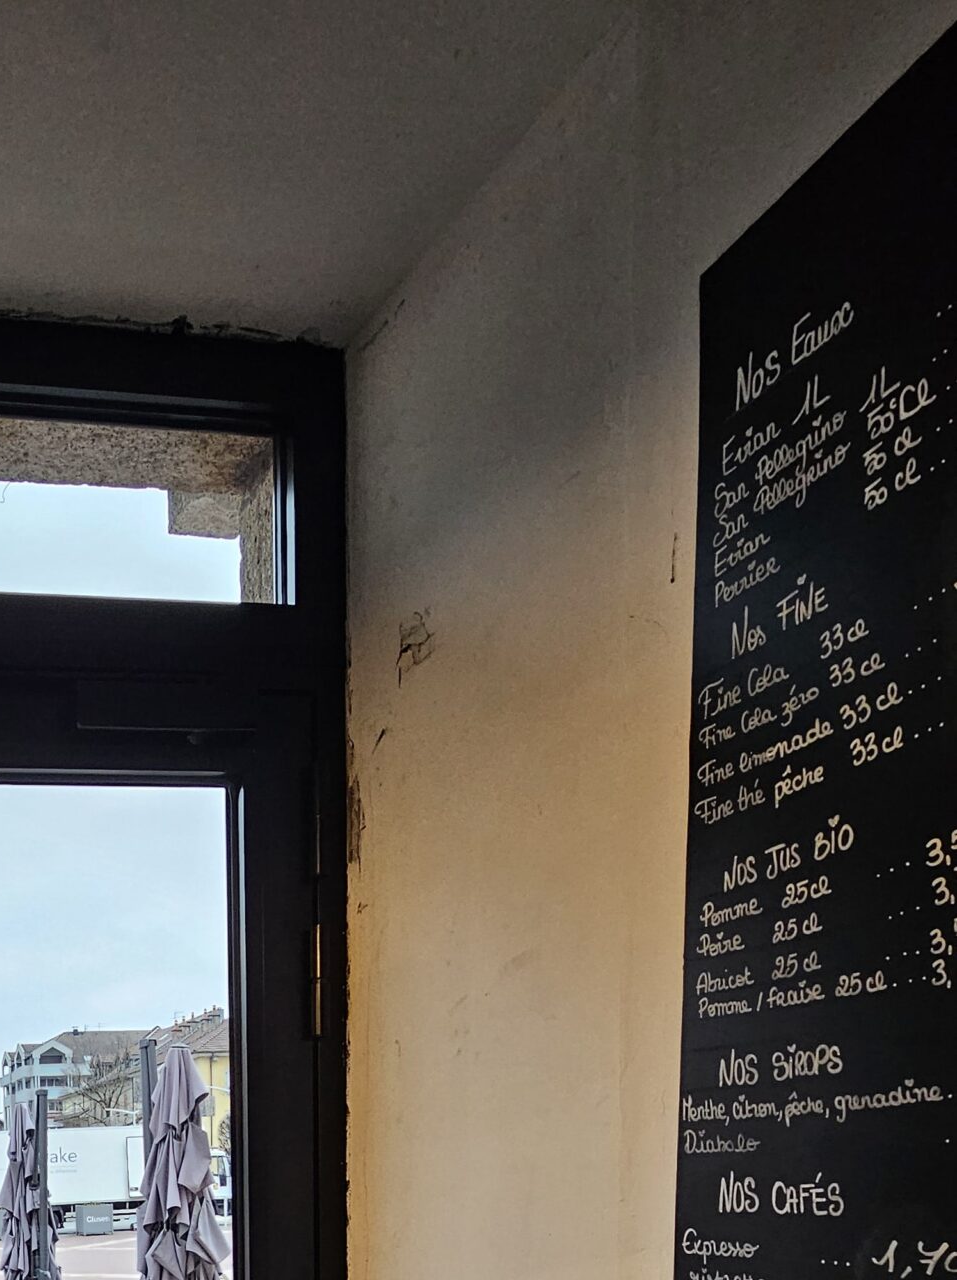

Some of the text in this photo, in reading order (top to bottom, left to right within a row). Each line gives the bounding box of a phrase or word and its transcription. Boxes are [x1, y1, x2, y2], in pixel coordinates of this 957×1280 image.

[736, 302, 854, 411] Nos Eaux
[715, 366, 901, 518] San Pellegrino 1L
[723, 375, 831, 476] Evian 1L
[713, 514, 749, 547] San
[753, 442, 851, 514] Pellegrino
[715, 533, 770, 577] Evian
[732, 606, 766, 659] Nos
[698, 678, 741, 719] Fine
[748, 664, 790, 696] Cola
[697, 759, 734, 787] Fine
[739, 717, 834, 773] limonade
[699, 723, 736, 749] Fine
[741, 708, 777, 734] Cola
[694, 796, 733, 824] Fine
[737, 778, 765, 811] thé
[774, 764, 824, 808] pêche
[723, 856, 758, 893] NOS
[764, 843, 801, 880] JUS
[700, 898, 763, 928] Pomme
[697, 932, 744, 957] Poire
[696, 966, 754, 995] Abricot
[719, 1049, 759, 1087] NOS
[683, 1078, 943, 1127] Menthe, citron, pêche, grenadine
[719, 1171, 844, 1216] NOS CAFÉS
[682, 1228, 759, 1265] Expresso
